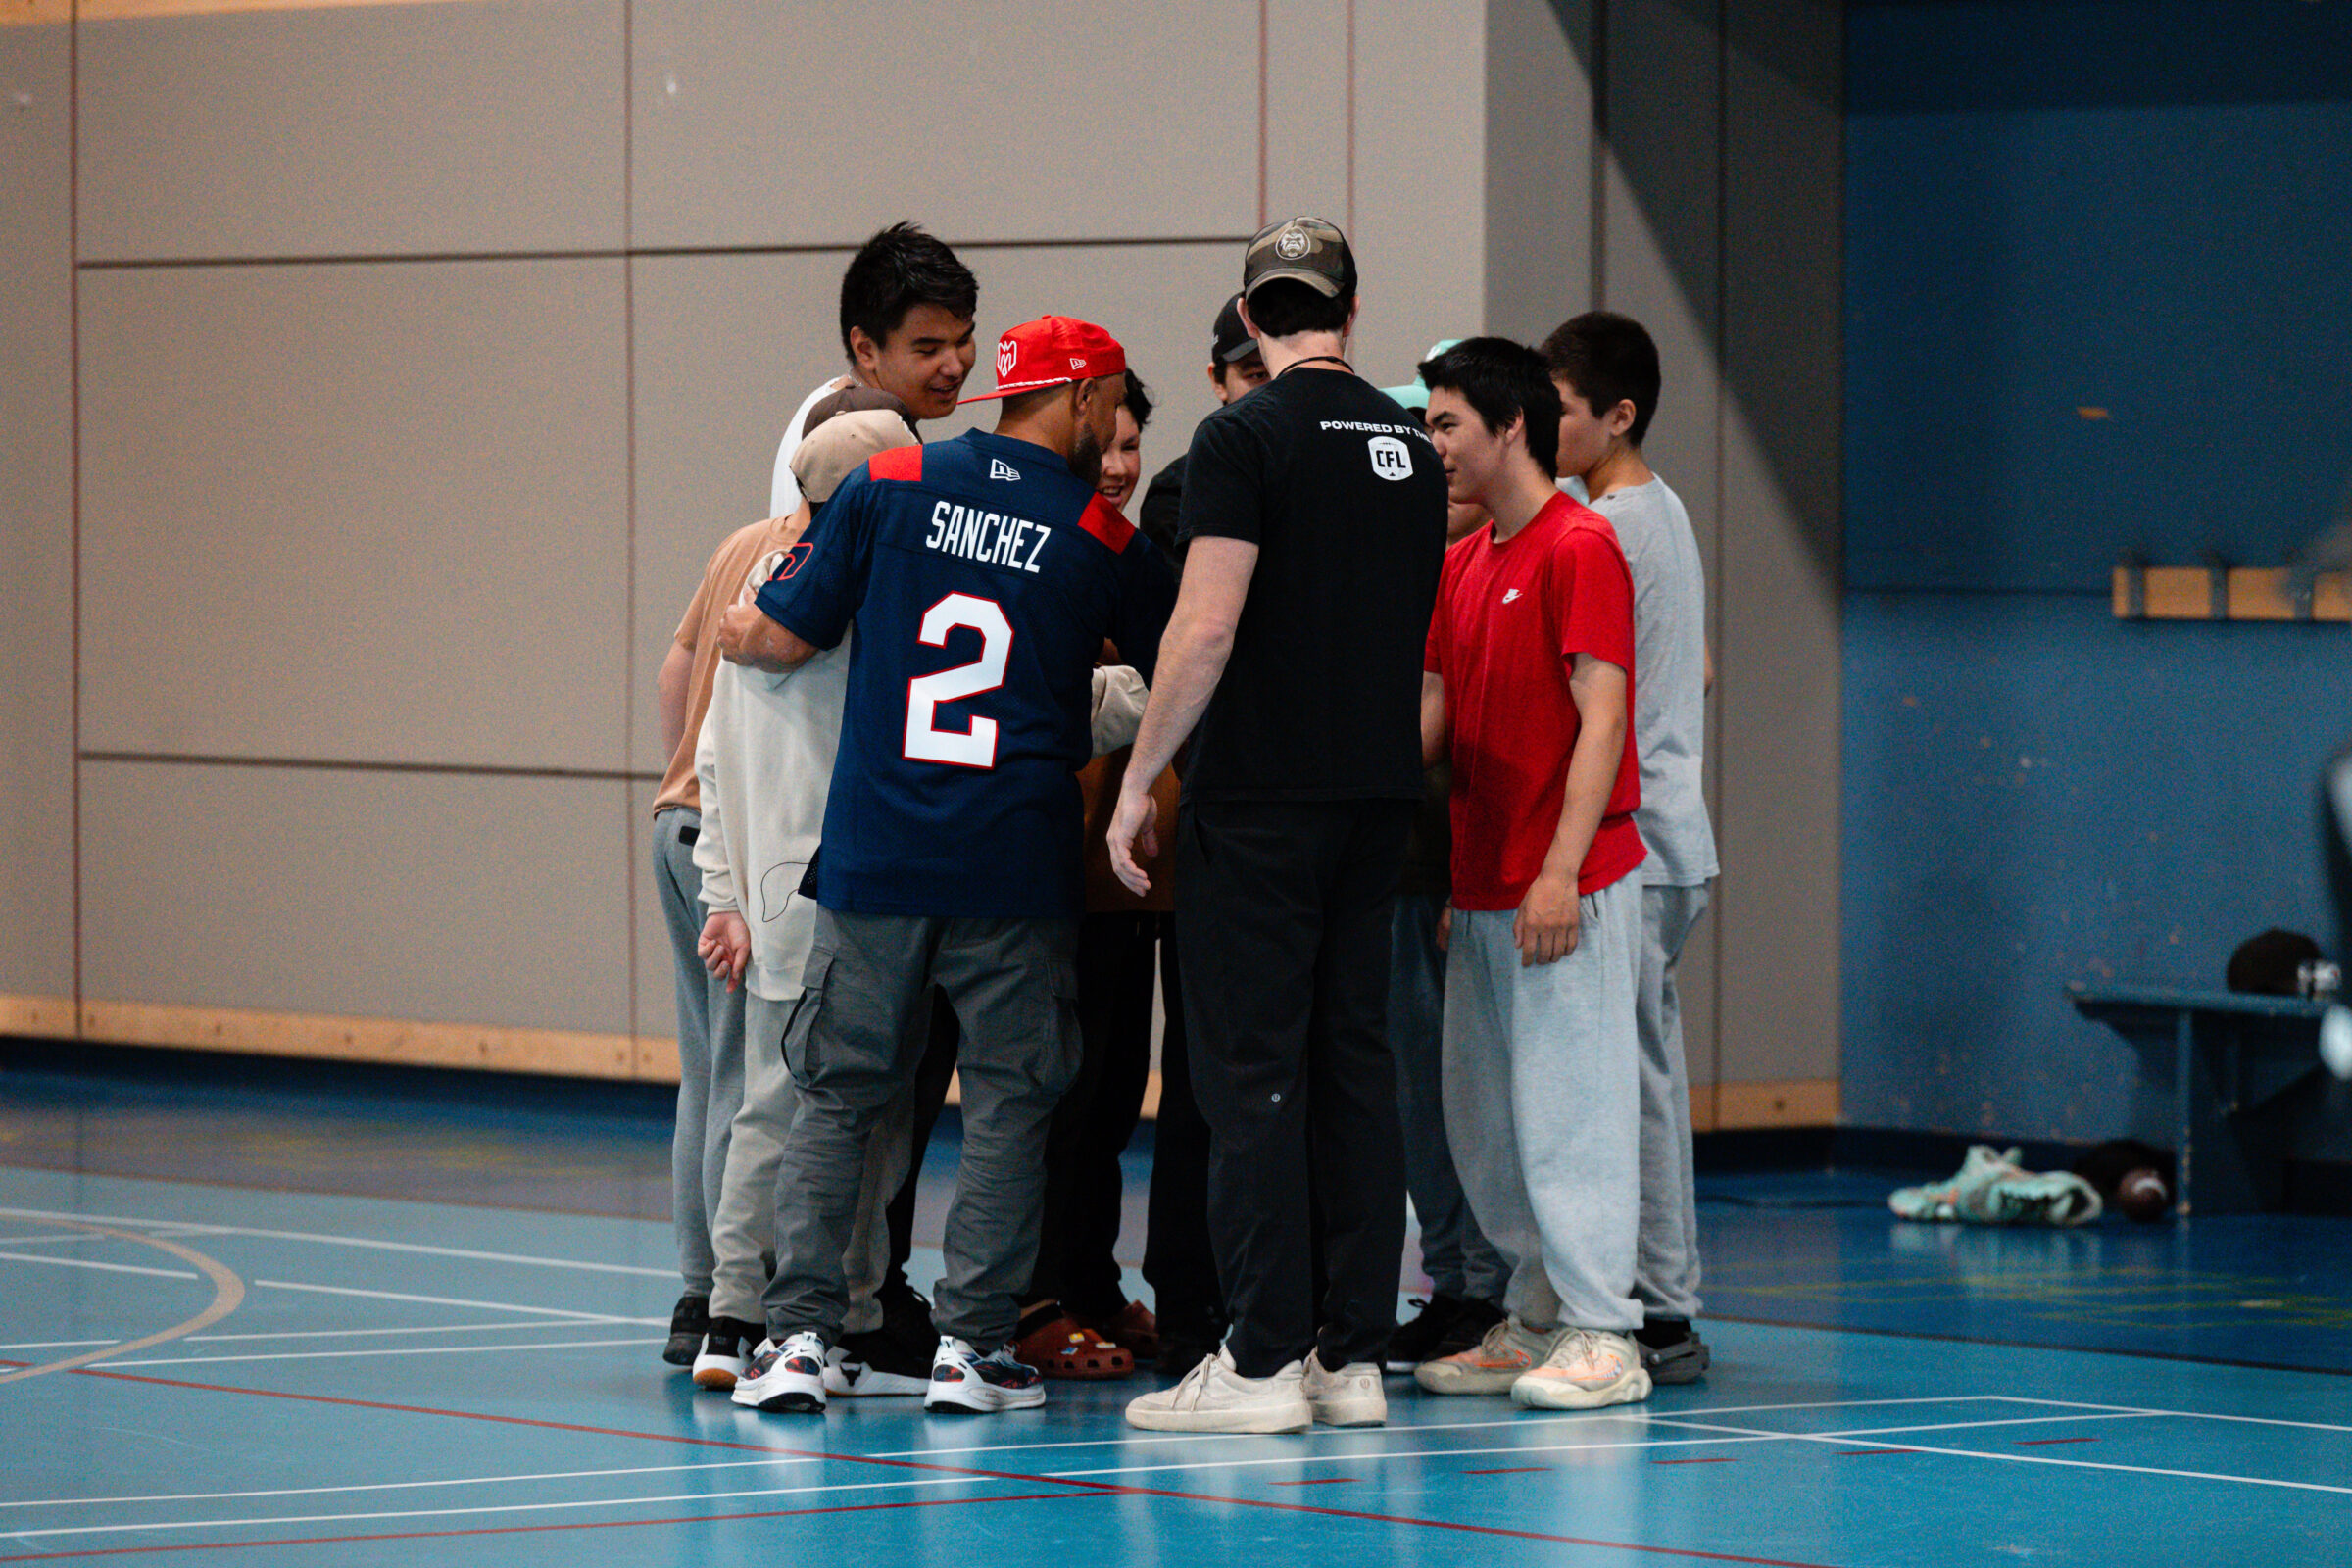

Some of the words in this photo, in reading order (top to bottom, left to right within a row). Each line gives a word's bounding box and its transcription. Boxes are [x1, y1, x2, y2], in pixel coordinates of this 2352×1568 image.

[1319, 420, 1393, 433] POWERED
[1393, 424, 1412, 435] BY
[1375, 450, 1406, 468] CFL
[925, 500, 1052, 573] SANCHEZ
[902, 590, 1015, 770] 2
